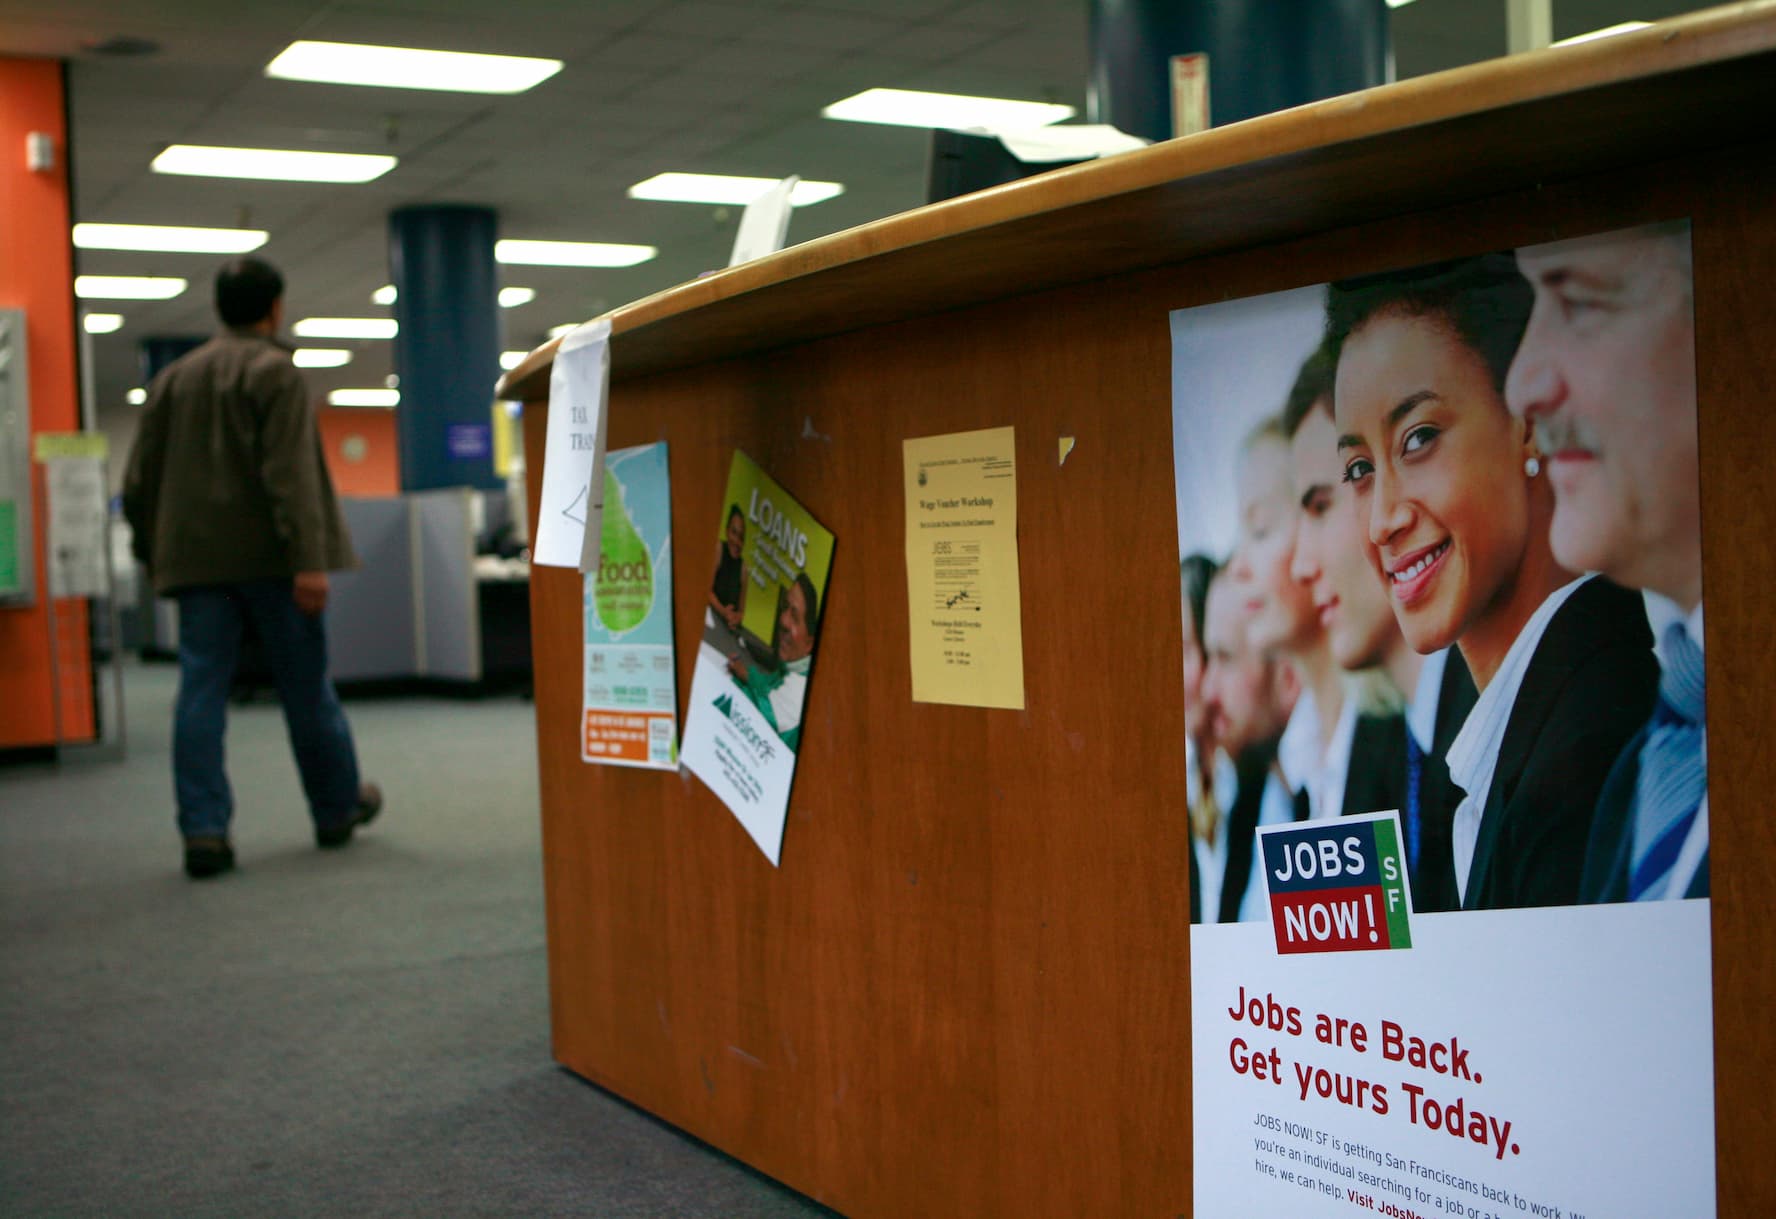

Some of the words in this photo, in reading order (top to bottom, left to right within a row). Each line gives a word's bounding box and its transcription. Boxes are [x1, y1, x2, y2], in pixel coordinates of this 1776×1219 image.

[749, 487, 808, 568] LOANS
[1274, 836, 1365, 882] JOBS
[1283, 894, 1379, 943] NOW!
[1228, 986, 1302, 1036] Jobs
[1315, 1013, 1367, 1053] are
[1381, 1020, 1483, 1084] Back.
[1229, 1037, 1282, 1085] Get
[1294, 1062, 1389, 1115] yours
[1401, 1082, 1520, 1160] Today.
[1254, 1113, 1281, 1132] JOBS
[1284, 1121, 1313, 1142] NOW!
[1315, 1131, 1328, 1145] SF
[1332, 1135, 1341, 1151] is
[1343, 1141, 1382, 1167] getting
[1385, 1152, 1407, 1172] San
[1410, 1160, 1478, 1195] Franciscans
[1482, 1183, 1510, 1206] back
[1514, 1193, 1527, 1211] to
[1254, 1137, 1286, 1157] you're
[1288, 1149, 1301, 1161] an
[1304, 1150, 1355, 1179] individual
[1358, 1171, 1411, 1201] searching
[1415, 1186, 1431, 1205] for
[1435, 1196, 1442, 1208] a
[1445, 1196, 1464, 1215] job
[1468, 1207, 1480, 1219] or
[1255, 1158, 1277, 1180] hire,
[1280, 1168, 1294, 1183] we
[1297, 1174, 1316, 1191] can
[1318, 1179, 1345, 1201] help.
[1347, 1188, 1374, 1210] Visit
